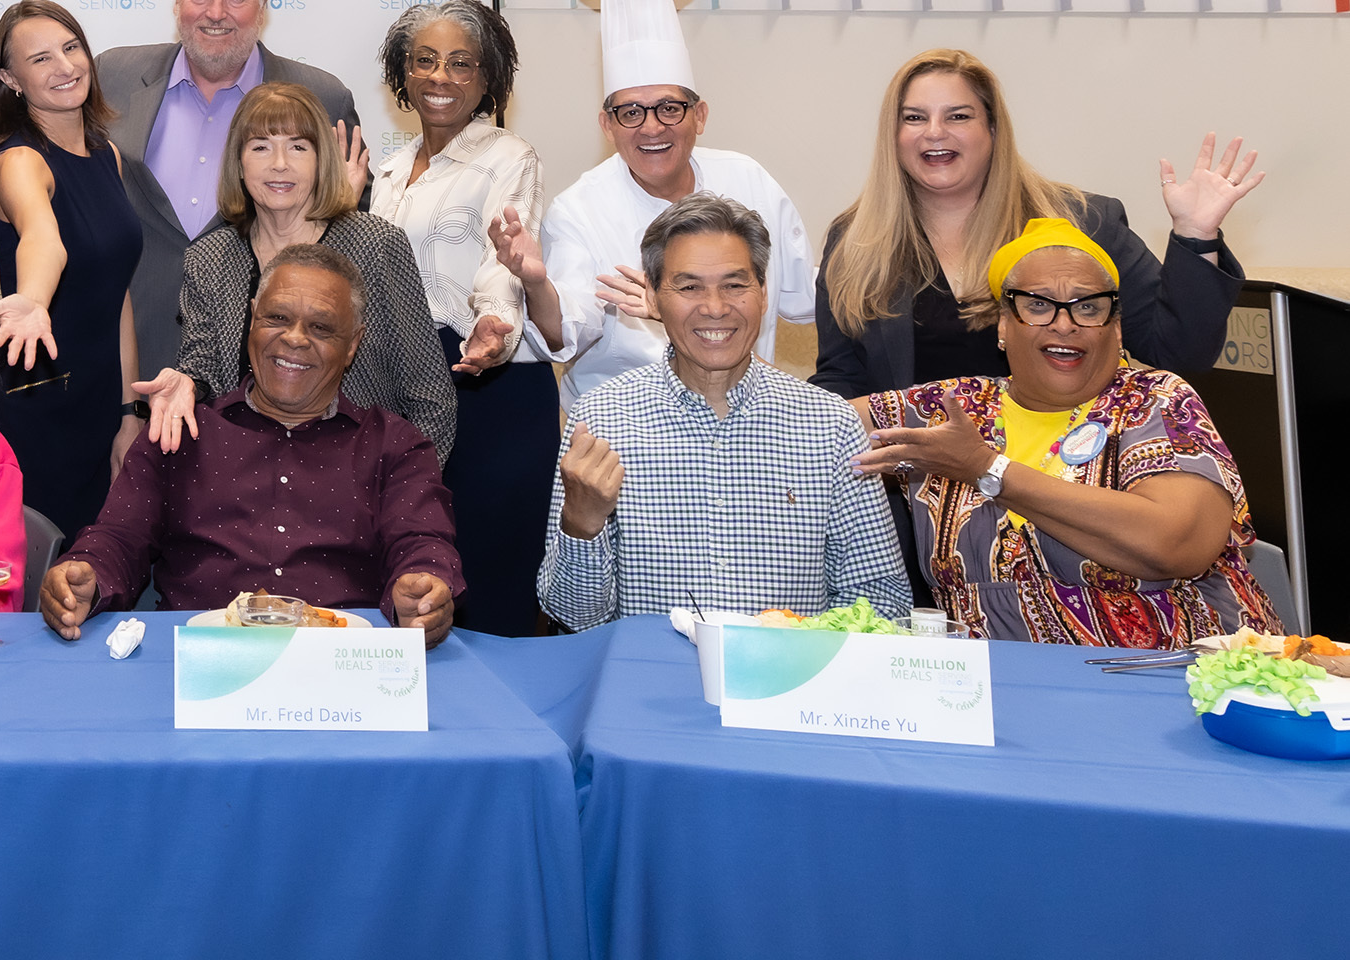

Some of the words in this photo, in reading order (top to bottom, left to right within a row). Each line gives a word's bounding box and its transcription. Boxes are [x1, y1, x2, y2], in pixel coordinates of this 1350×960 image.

[334, 648, 348, 658] 20
[352, 648, 403, 658] MILLION
[335, 660, 373, 670] MEALS
[890, 656, 905, 667] 20
[909, 658, 965, 671] MILLION
[891, 669, 932, 681] MEALS
[246, 707, 271, 721] Mr.
[278, 707, 313, 722] Fred
[319, 708, 362, 722] Davis
[800, 710, 827, 726] Mr.
[833, 713, 890, 731] Xinzhe
[896, 718, 917, 733] Yu
